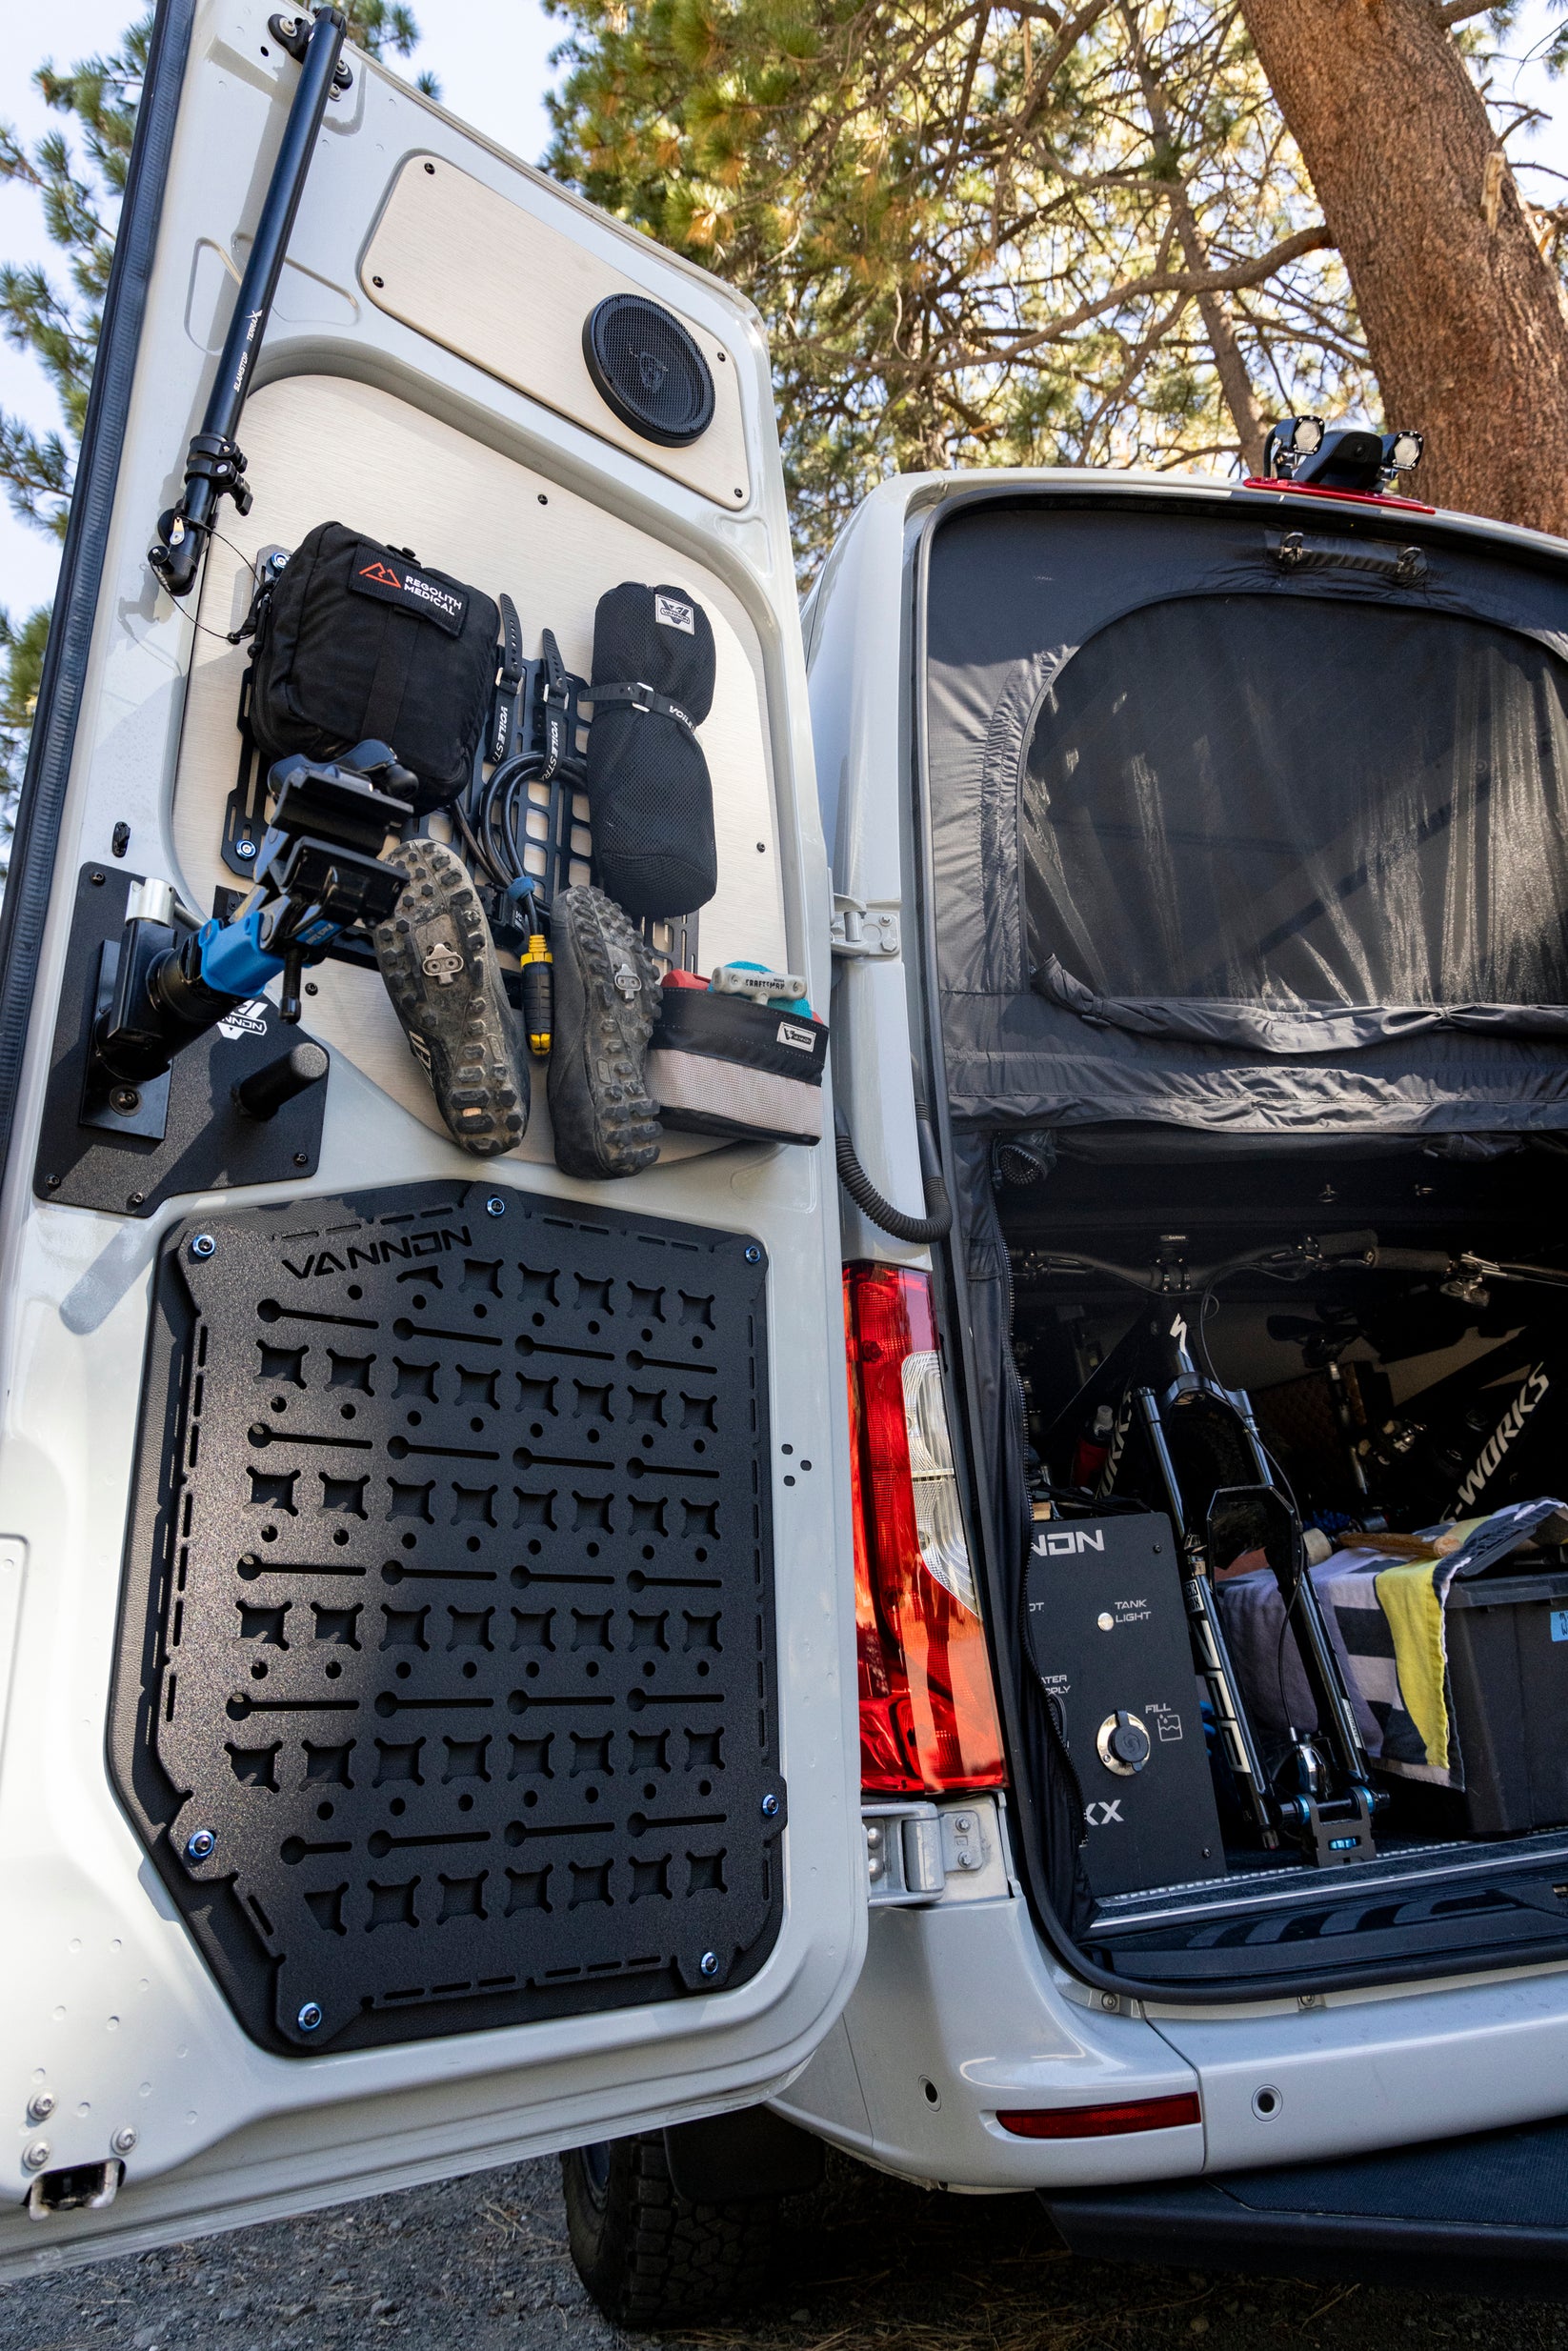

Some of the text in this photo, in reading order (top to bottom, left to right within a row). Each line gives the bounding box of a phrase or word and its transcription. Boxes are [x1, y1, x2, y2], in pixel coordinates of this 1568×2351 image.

[233, 352, 249, 392] SLAMSTOP
[403, 583, 455, 616] MEDICAL
[405, 574, 463, 610] REGOLITH
[497, 706, 509, 745] VOILE
[551, 720, 559, 757] VOILE
[281, 1225, 473, 1279] VANNON
[1115, 1599, 1147, 1610] TANK
[1116, 1611, 1152, 1623] LIGHT
[1145, 1703, 1172, 1714] FILL
